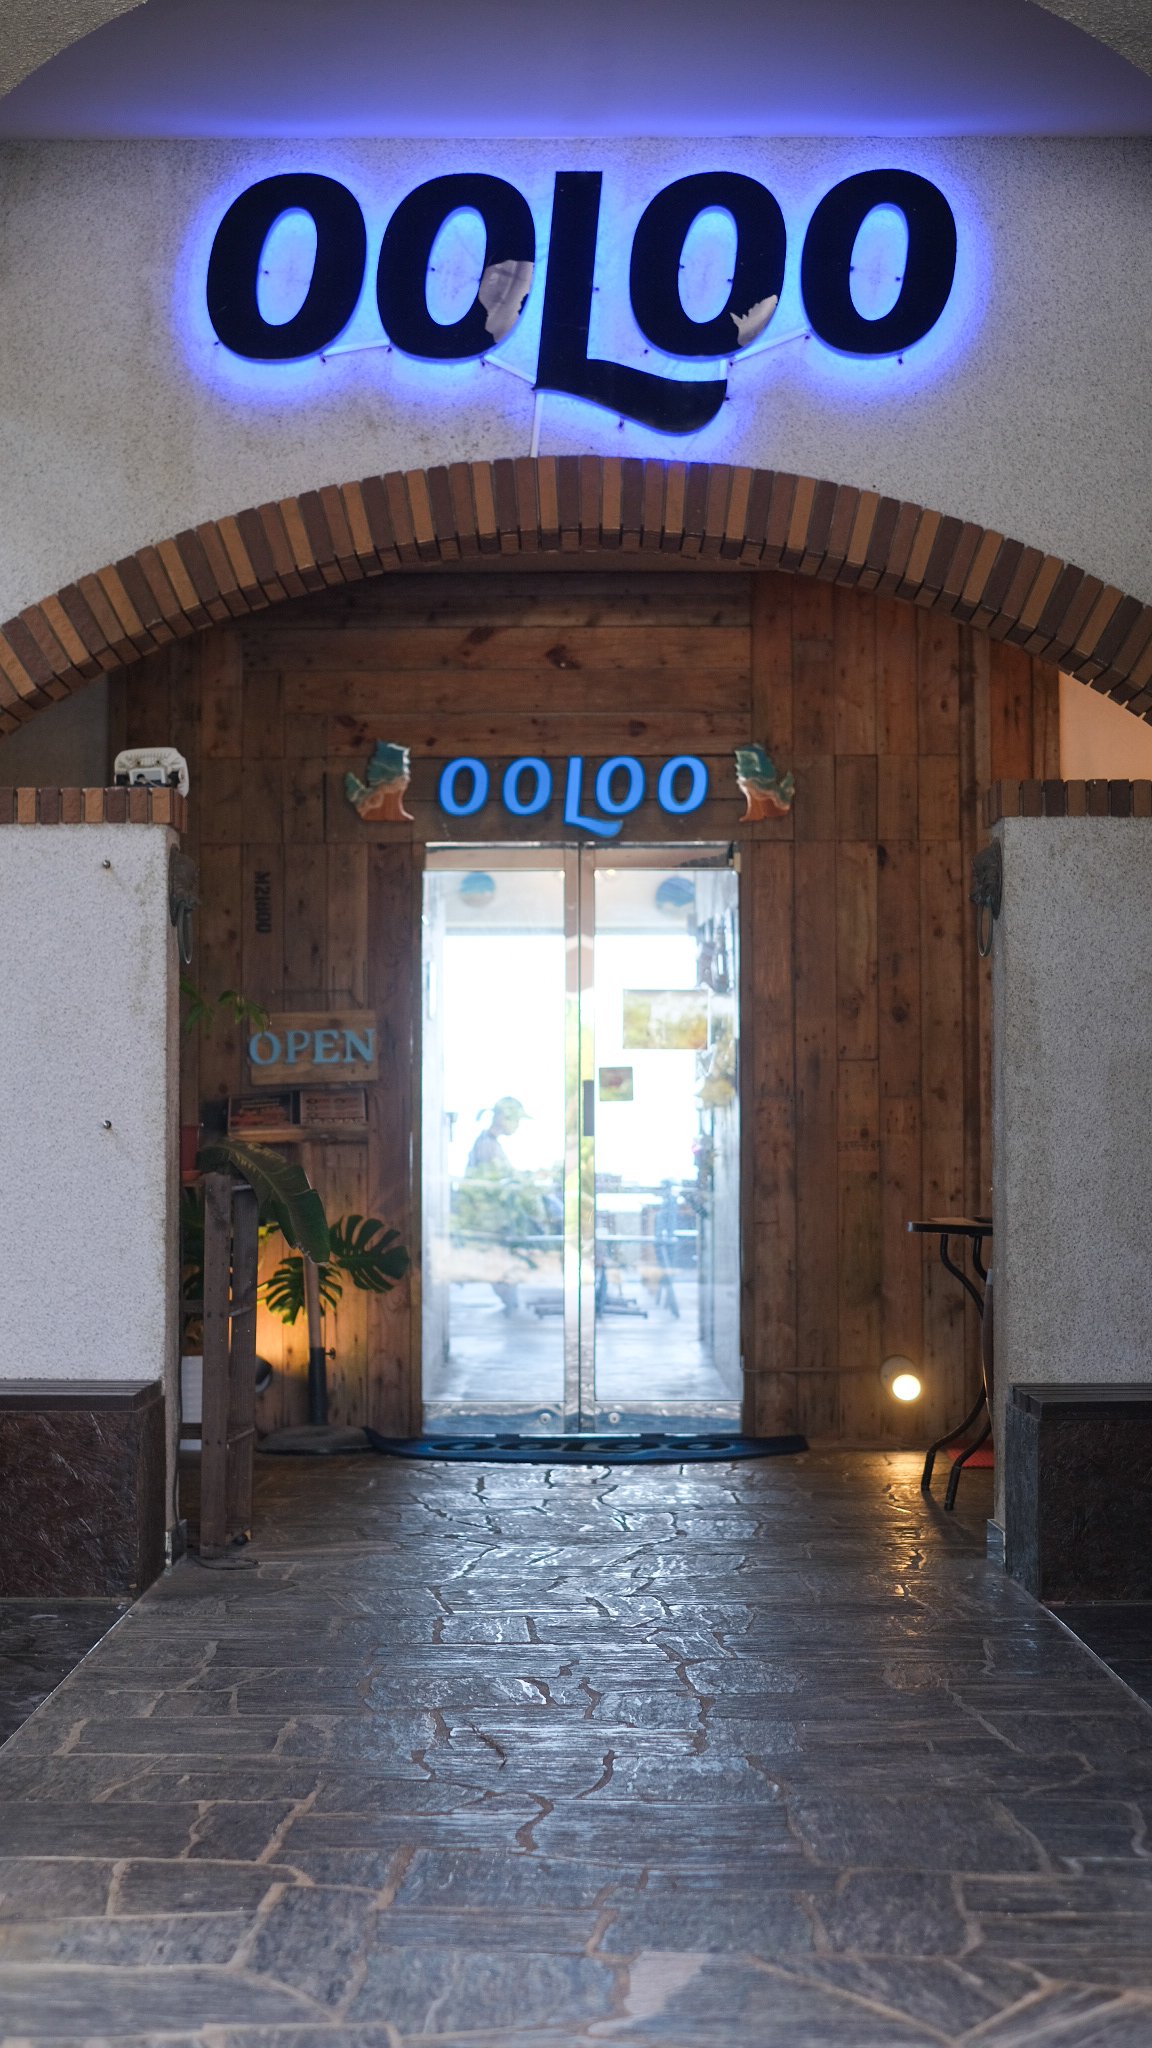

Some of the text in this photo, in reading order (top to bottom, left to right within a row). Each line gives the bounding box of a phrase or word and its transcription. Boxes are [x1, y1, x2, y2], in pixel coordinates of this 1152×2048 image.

[206, 168, 957, 433] OOLOO
[439, 755, 708, 837] OOLOO
[249, 1027, 376, 1065] OPEN
